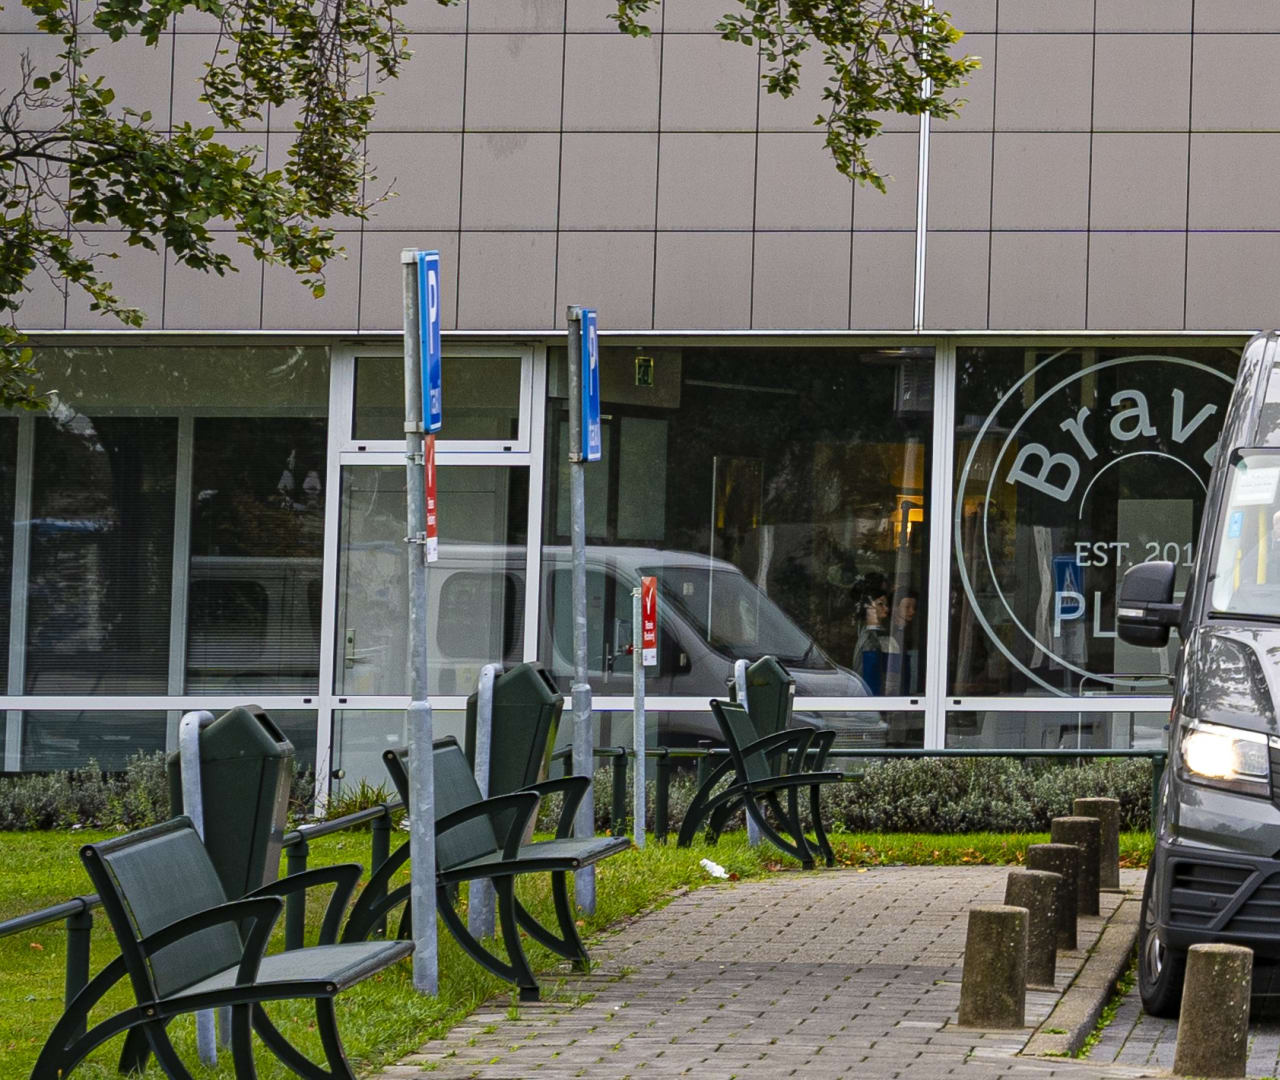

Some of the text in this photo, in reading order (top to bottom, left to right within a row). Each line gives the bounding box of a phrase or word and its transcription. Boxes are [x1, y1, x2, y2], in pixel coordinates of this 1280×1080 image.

[1006, 388, 1219, 502] Brav
[1074, 541, 1195, 567] EST. 201
